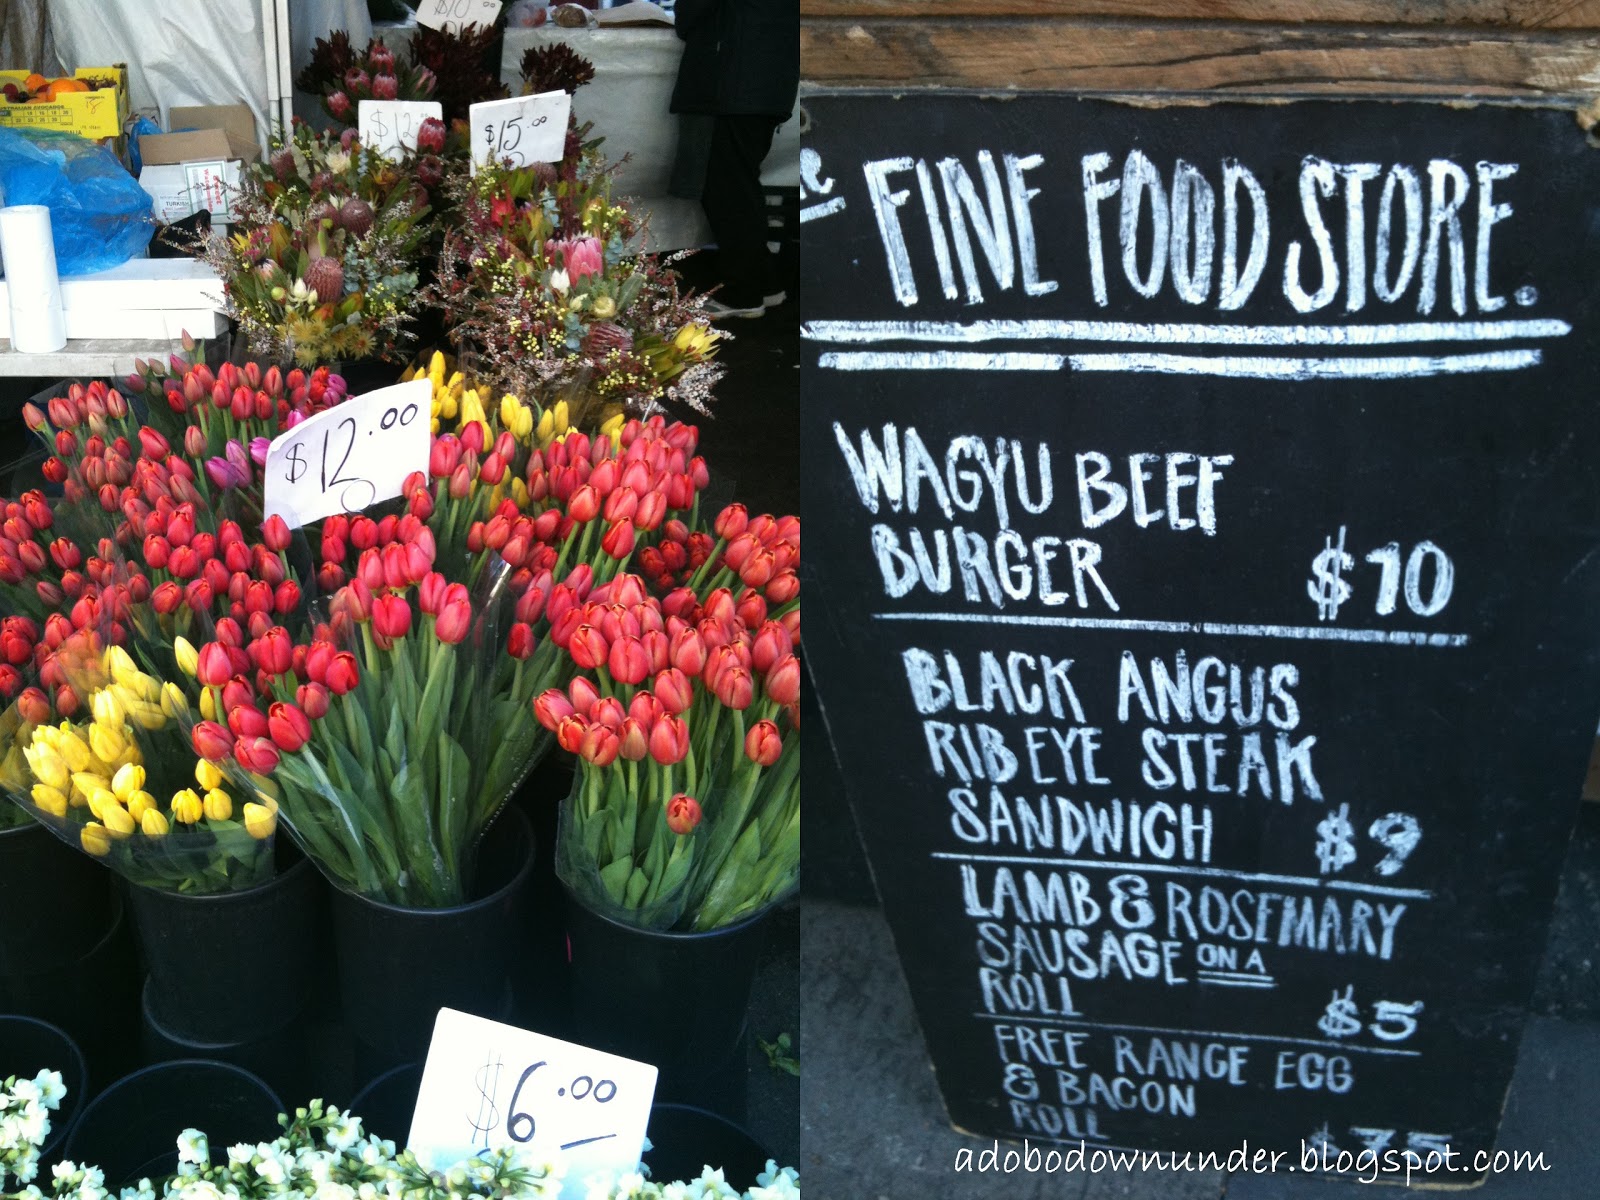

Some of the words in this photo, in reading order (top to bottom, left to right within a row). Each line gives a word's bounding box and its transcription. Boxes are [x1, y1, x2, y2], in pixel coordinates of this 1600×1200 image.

[484, 115, 548, 151] $15.00
[863, 149, 1059, 307] FINE
[1081, 149, 1270, 311] FOOD
[1283, 154, 1539, 316] STORE.
[285, 403, 418, 494] $12.00
[833, 421, 1054, 530] WAGYU
[1075, 451, 1234, 536] BEEF
[871, 523, 1120, 611] BURGER
[1307, 525, 1454, 621] $10
[902, 647, 1087, 723] BLACK
[1118, 648, 1301, 730] ANGUS
[1141, 726, 1324, 805] STEAK
[948, 785, 1212, 863] SANDWICH
[960, 864, 1101, 926] LAMB
[1108, 874, 1156, 929] &
[1166, 881, 1407, 960] ROSEMARY
[976, 922, 1188, 986] SAUSAGE
[1197, 943, 1238, 971] ON
[1244, 947, 1267, 974] A
[979, 967, 1085, 1017] ROLL
[994, 1024, 1090, 1069] FREE
[1112, 1034, 1250, 1086] RANGE
[1275, 1051, 1354, 1094] EGG
[1003, 1062, 1039, 1101] &
[1056, 1069, 1196, 1118] BACON
[466, 1049, 618, 1149] $6.00
[1008, 1099, 1111, 1139] ROLL
